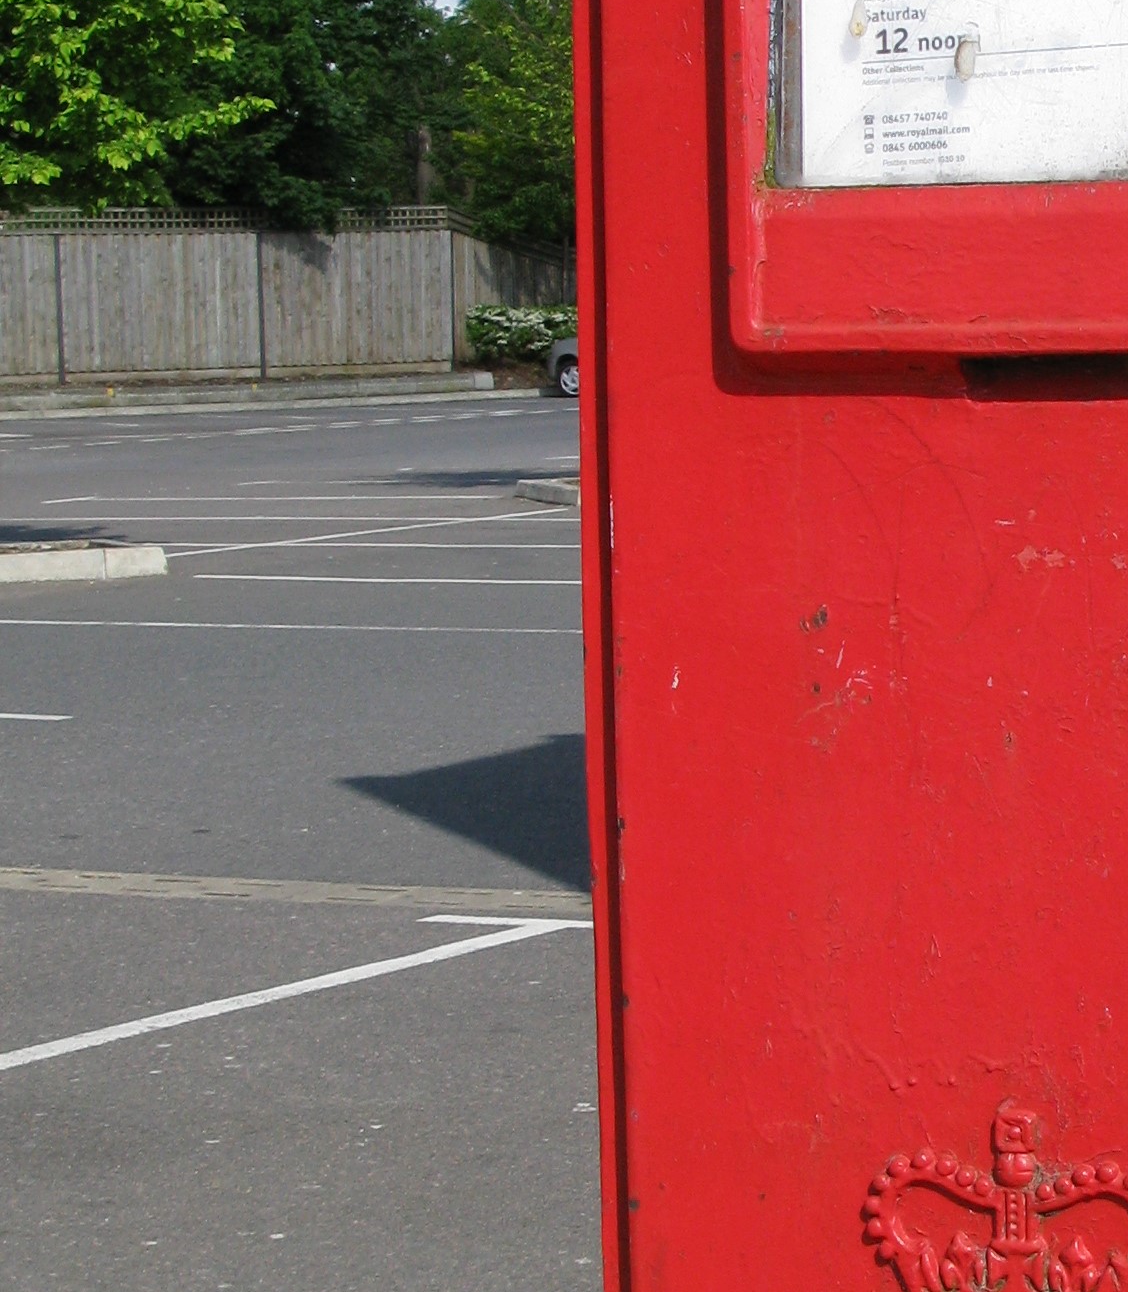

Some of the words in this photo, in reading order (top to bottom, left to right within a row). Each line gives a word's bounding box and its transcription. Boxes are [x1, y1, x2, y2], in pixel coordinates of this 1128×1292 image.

[866, 7, 927, 23] Saturday
[876, 28, 908, 54] 12
[918, 35, 966, 52] noo
[862, 67, 883, 75] Other
[885, 64, 925, 74] Collections
[882, 114, 911, 124] 08457
[914, 111, 949, 122] 740740
[882, 127, 970, 138] www.royalmail.com
[882, 143, 905, 152] 0845
[908, 140, 949, 151] 6000606
